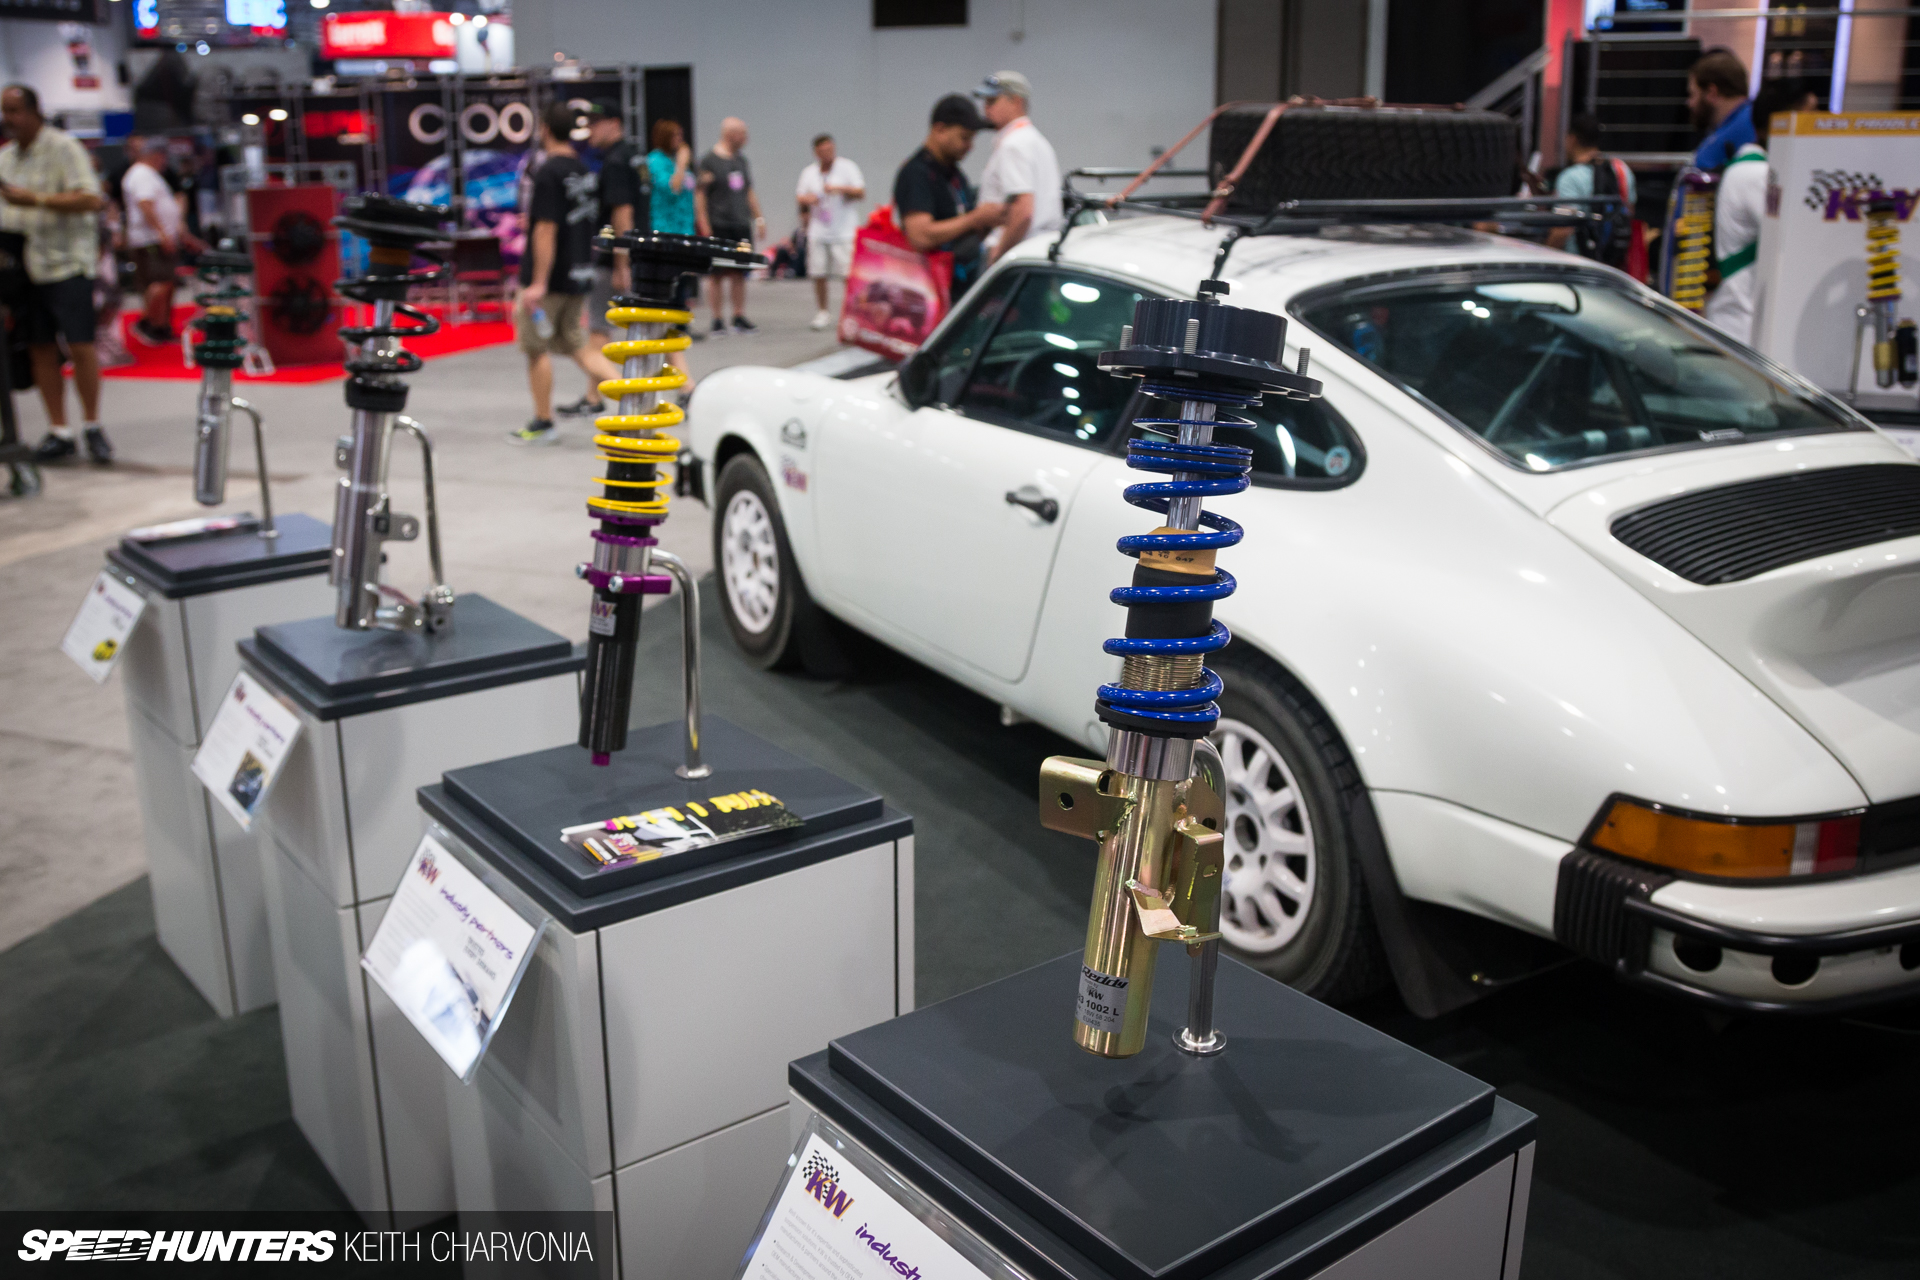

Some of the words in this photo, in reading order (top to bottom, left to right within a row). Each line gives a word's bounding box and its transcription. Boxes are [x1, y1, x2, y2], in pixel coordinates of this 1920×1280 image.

[1086, 1000, 1109, 1014] 1002
[1113, 1008, 1119, 1016] L
[804, 1166, 856, 1220] KW
